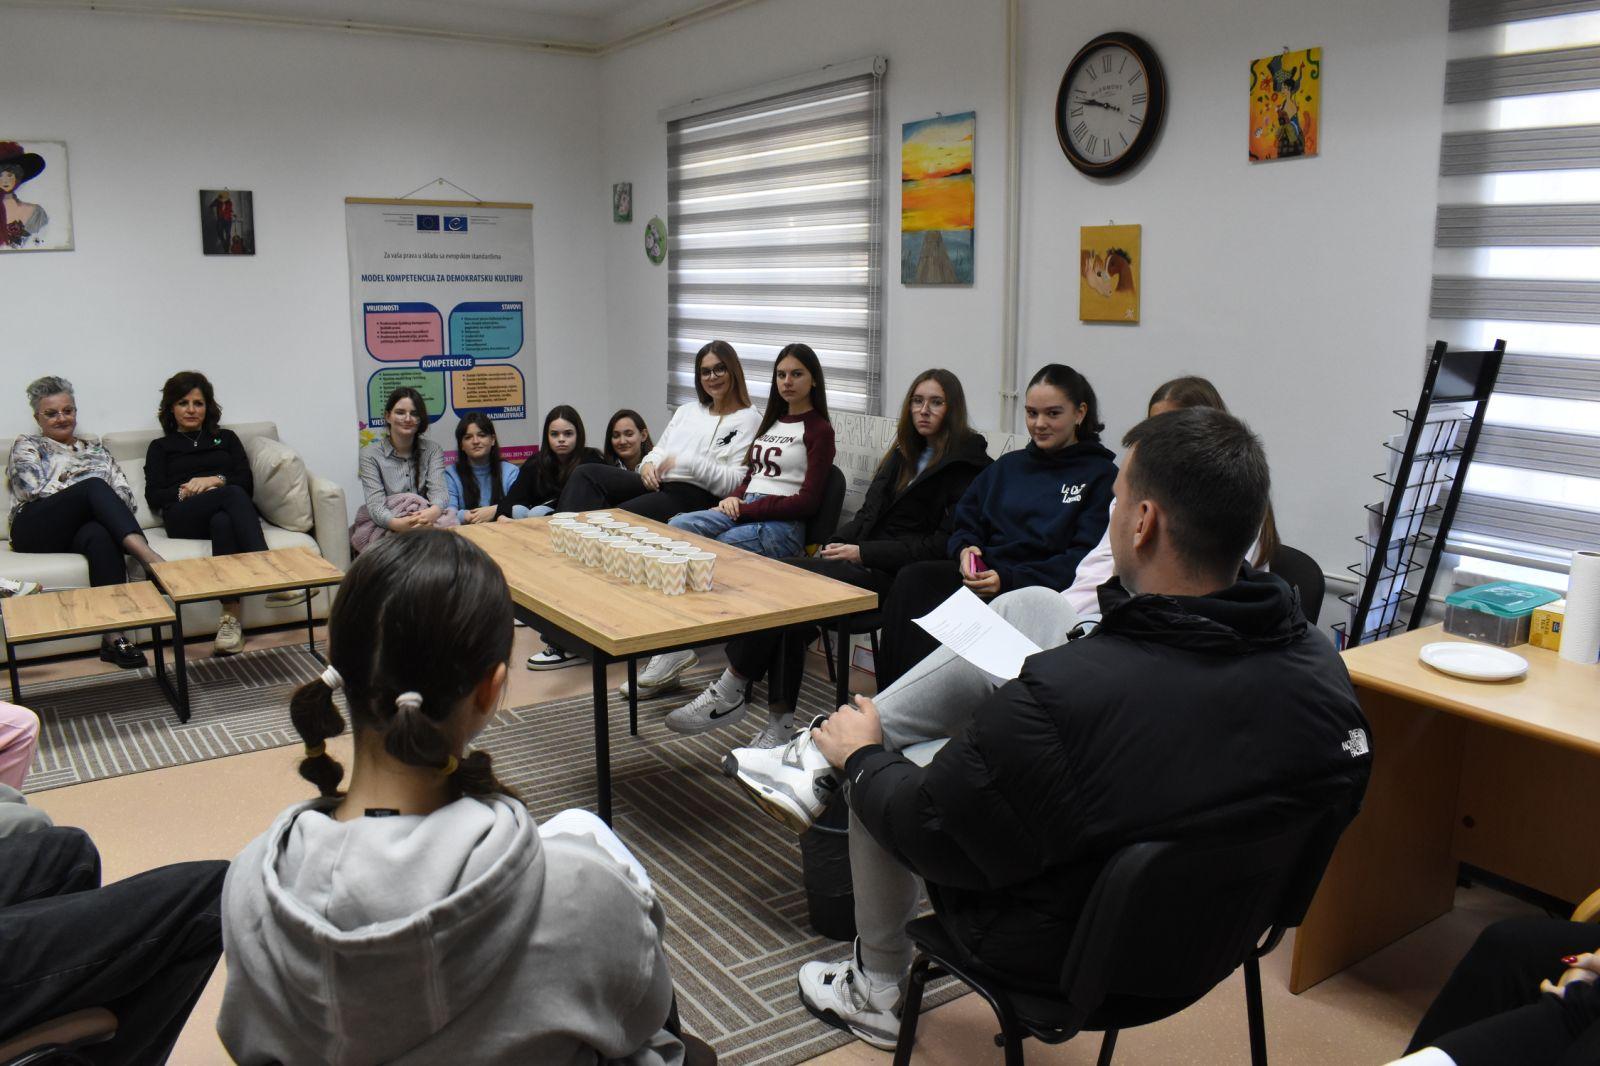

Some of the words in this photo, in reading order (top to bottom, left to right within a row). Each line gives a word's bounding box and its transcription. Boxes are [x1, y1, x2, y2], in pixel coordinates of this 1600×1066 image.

[383, 251, 390, 259] Za
[361, 274, 385, 282] MODEL
[386, 274, 436, 282] KOMPETENCIJA
[437, 274, 445, 282] ZA
[446, 274, 493, 282] DEMOKRATSKU
[494, 274, 523, 282] KULTURU
[366, 304, 399, 312] VRIJEDNOSTI
[422, 358, 472, 368] KOMPETENCIJE
[758, 434, 797, 444] OUSTON
